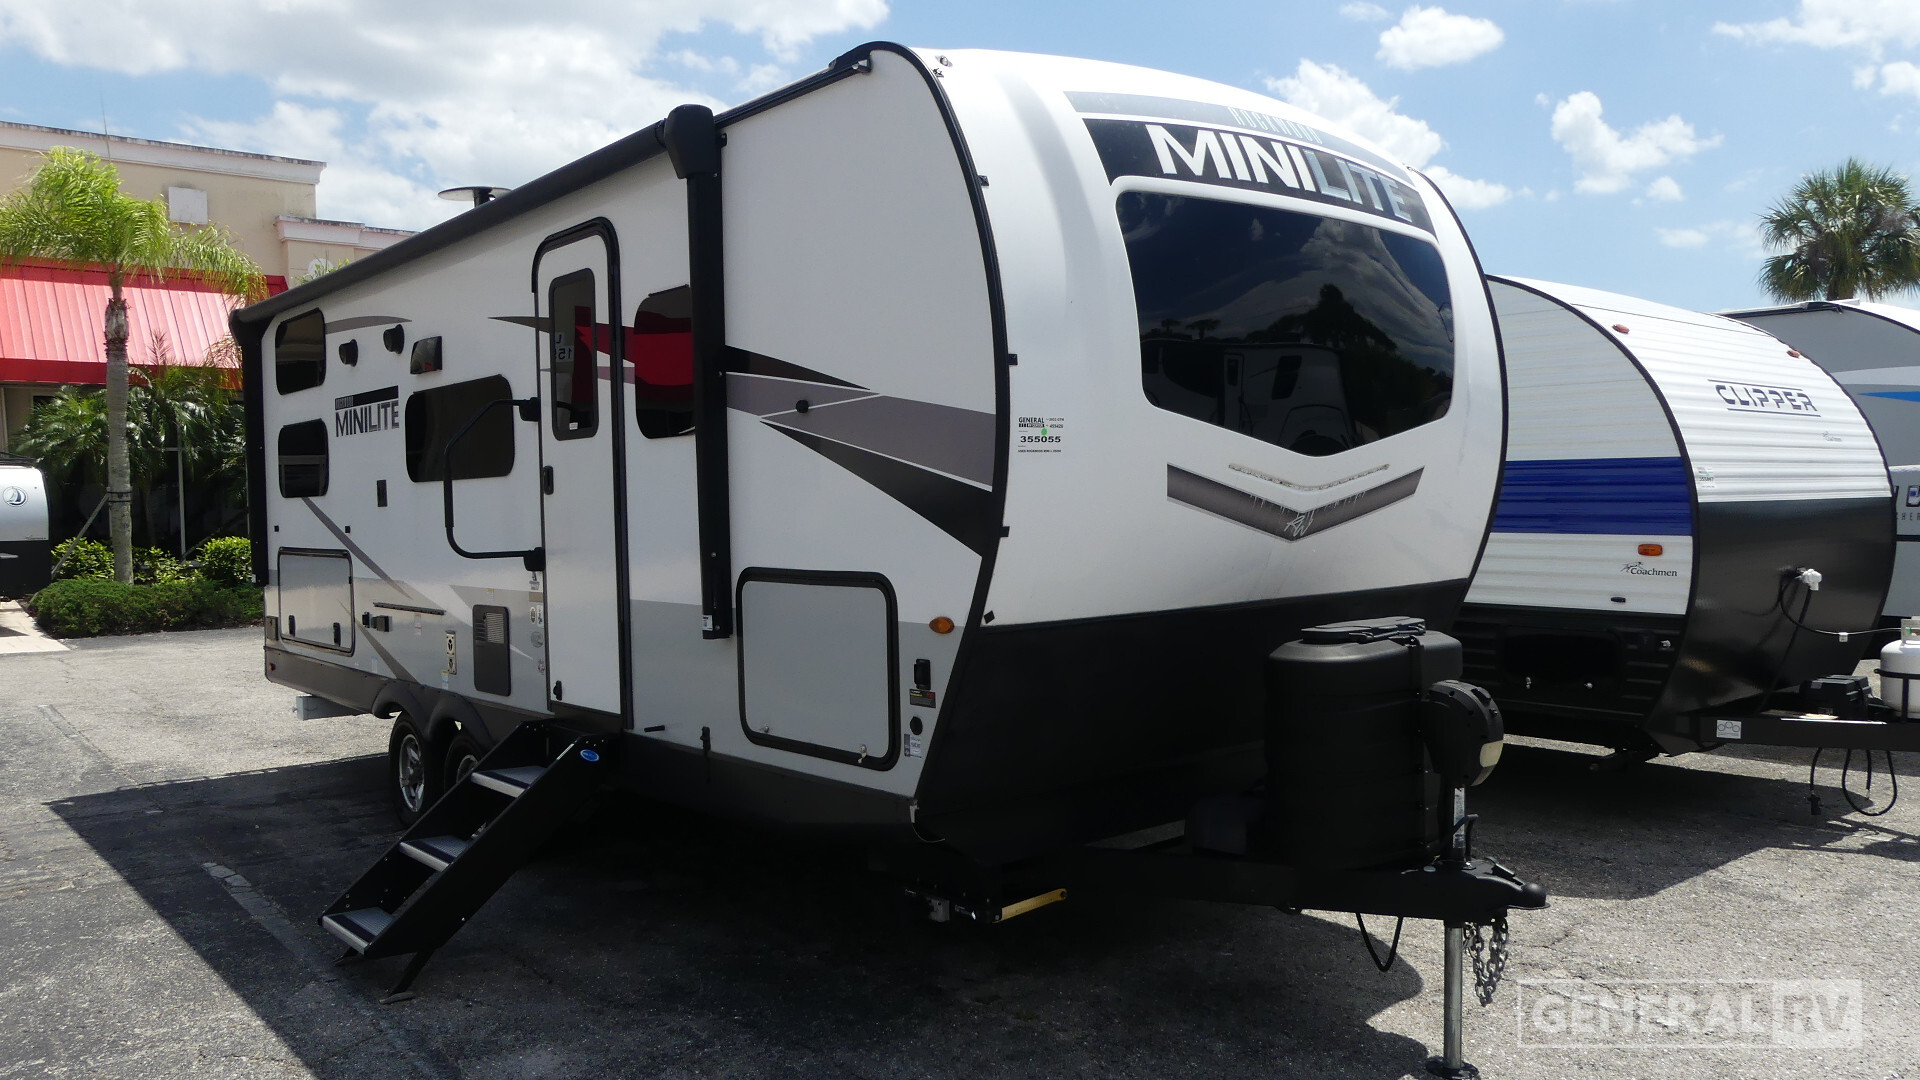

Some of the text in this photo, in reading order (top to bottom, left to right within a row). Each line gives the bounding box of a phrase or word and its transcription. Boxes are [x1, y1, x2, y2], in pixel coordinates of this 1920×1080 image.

[1227, 106, 1323, 145] ROCKWOOD
[1145, 123, 1413, 223] MINILITE
[1715, 384, 1818, 412] CLIPPER
[335, 400, 399, 437] MINILITE
[1018, 416, 1045, 424] GENERAL
[1020, 435, 1062, 443] 355055
[1630, 567, 1678, 577] Coachmen
